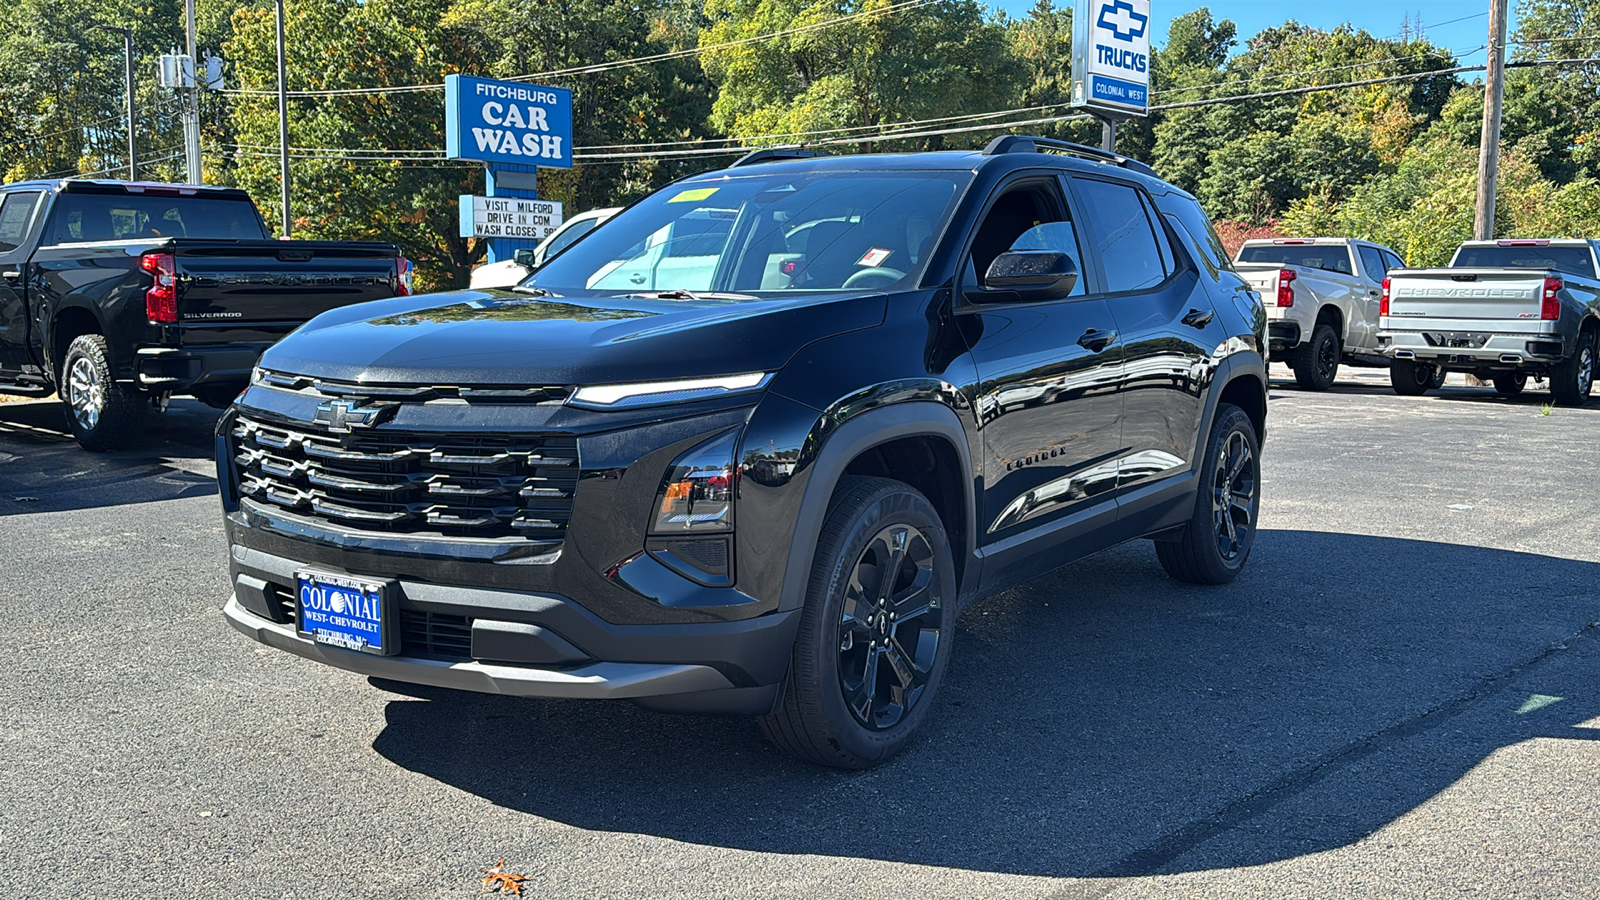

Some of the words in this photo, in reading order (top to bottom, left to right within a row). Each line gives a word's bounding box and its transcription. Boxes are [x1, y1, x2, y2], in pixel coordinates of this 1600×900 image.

[1096, 44, 1146, 73] TRUCKS
[476, 83, 557, 105] FITCHBURG
[1096, 83, 1125, 97] COLONIAL
[1128, 89, 1144, 101] WEST
[482, 101, 549, 132] CAR
[471, 127, 562, 159] WASH
[484, 199, 509, 211] VISIT
[517, 202, 553, 214] MILFORD
[487, 212, 513, 223] DRIVE
[518, 214, 527, 224] IN
[533, 215, 550, 226] COM
[476, 224, 501, 235] WASH
[505, 225, 537, 237] CLOSES
[543, 227, 557, 238] 9P
[1397, 288, 1532, 298] CHEVROLET
[1006, 446, 1066, 471] EQUINOX
[300, 585, 381, 622] COLONIAL
[329, 615, 379, 633] CHEVROLET
